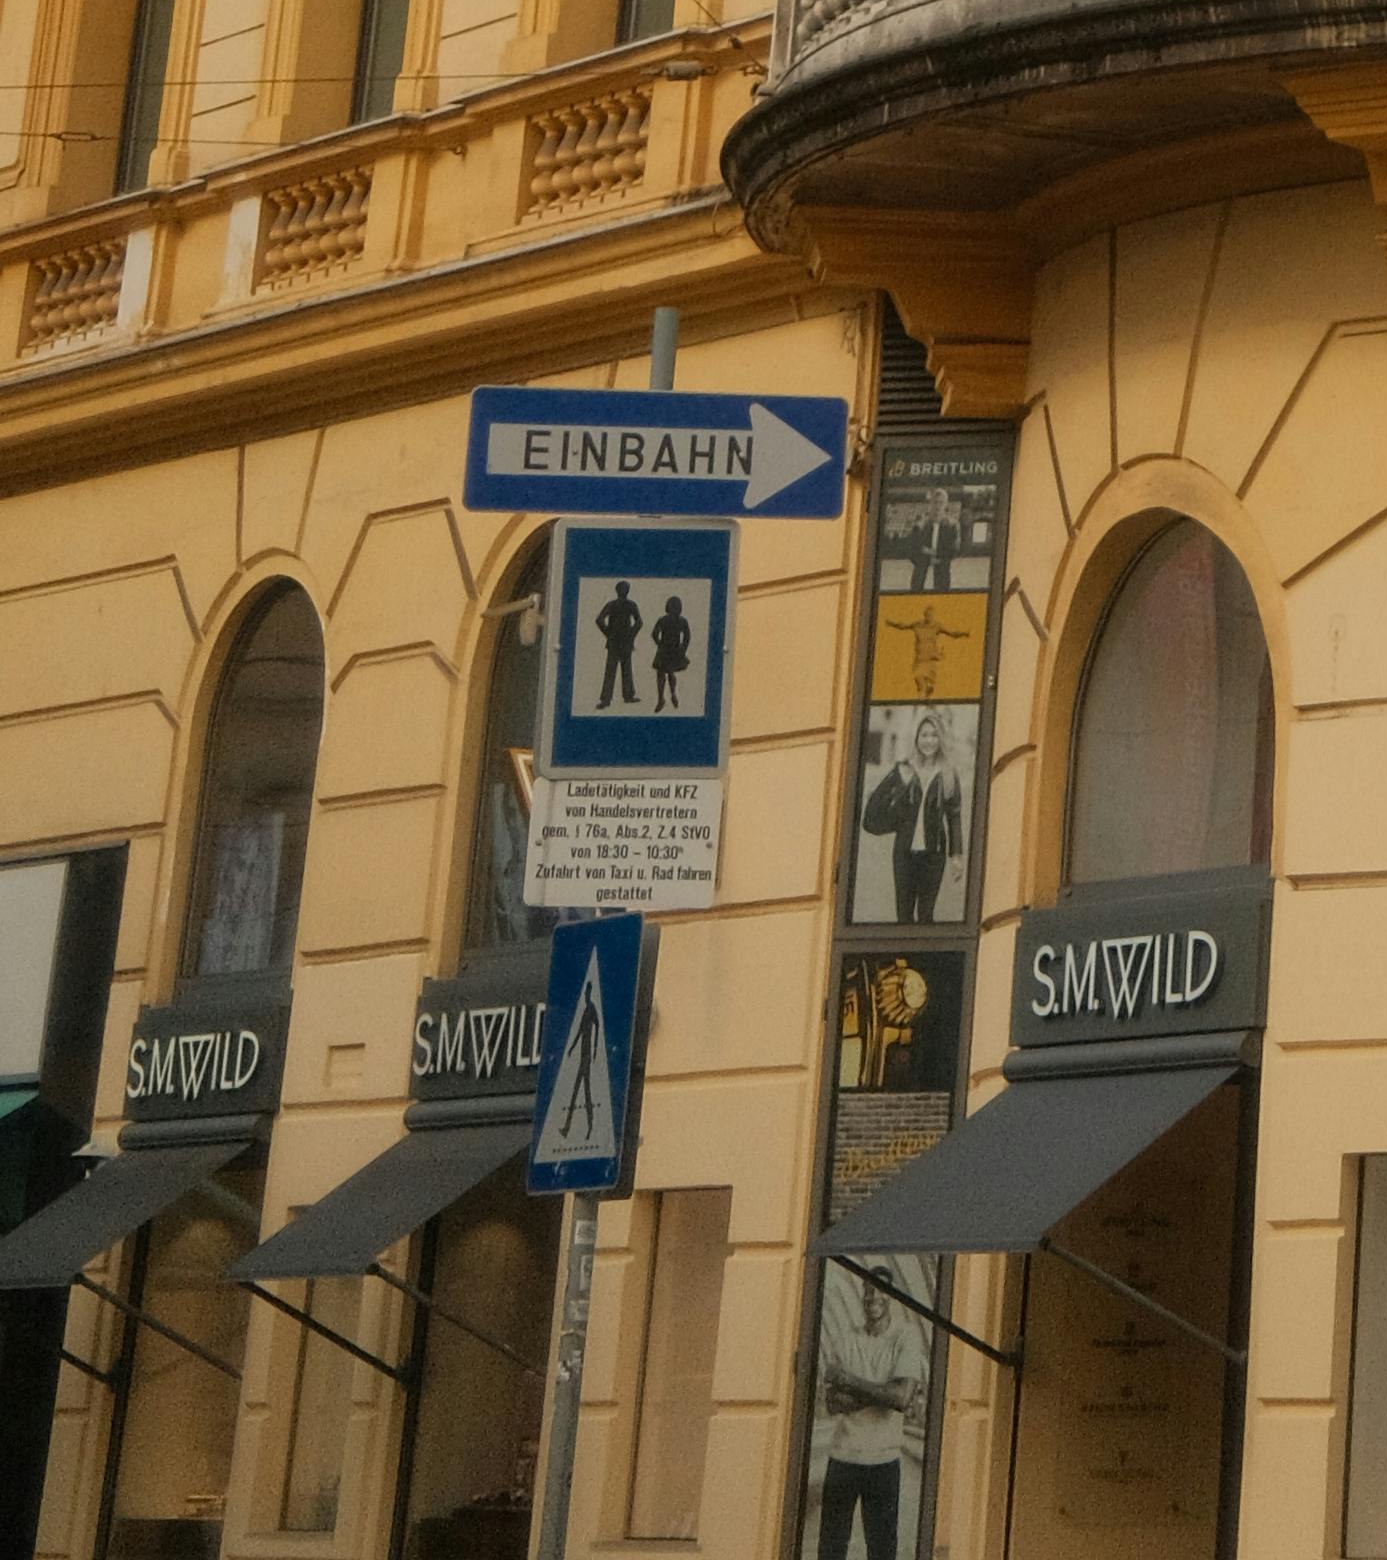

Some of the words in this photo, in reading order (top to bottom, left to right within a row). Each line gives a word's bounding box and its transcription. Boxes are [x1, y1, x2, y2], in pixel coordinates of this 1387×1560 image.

[523, 428, 753, 477] EINBAHN
[909, 461, 998, 476] BREITLING
[567, 782, 645, 800] Ladetätigkeit
[650, 785, 670, 799] und
[675, 784, 698, 800] KFZ
[565, 805, 586, 818] von
[590, 804, 698, 819] Handelsvertretern
[542, 825, 570, 839] gem.
[681, 825, 711, 840] StVO
[570, 846, 591, 859] von
[596, 845, 629, 859] 18:30
[535, 864, 581, 879] Zufahrt
[585, 867, 606, 879] von
[610, 865, 633, 880] Taxi
[637, 867, 647, 880] u.
[651, 865, 673, 881] Rad
[677, 866, 712, 881] fahren
[596, 886, 653, 902] gestattet
